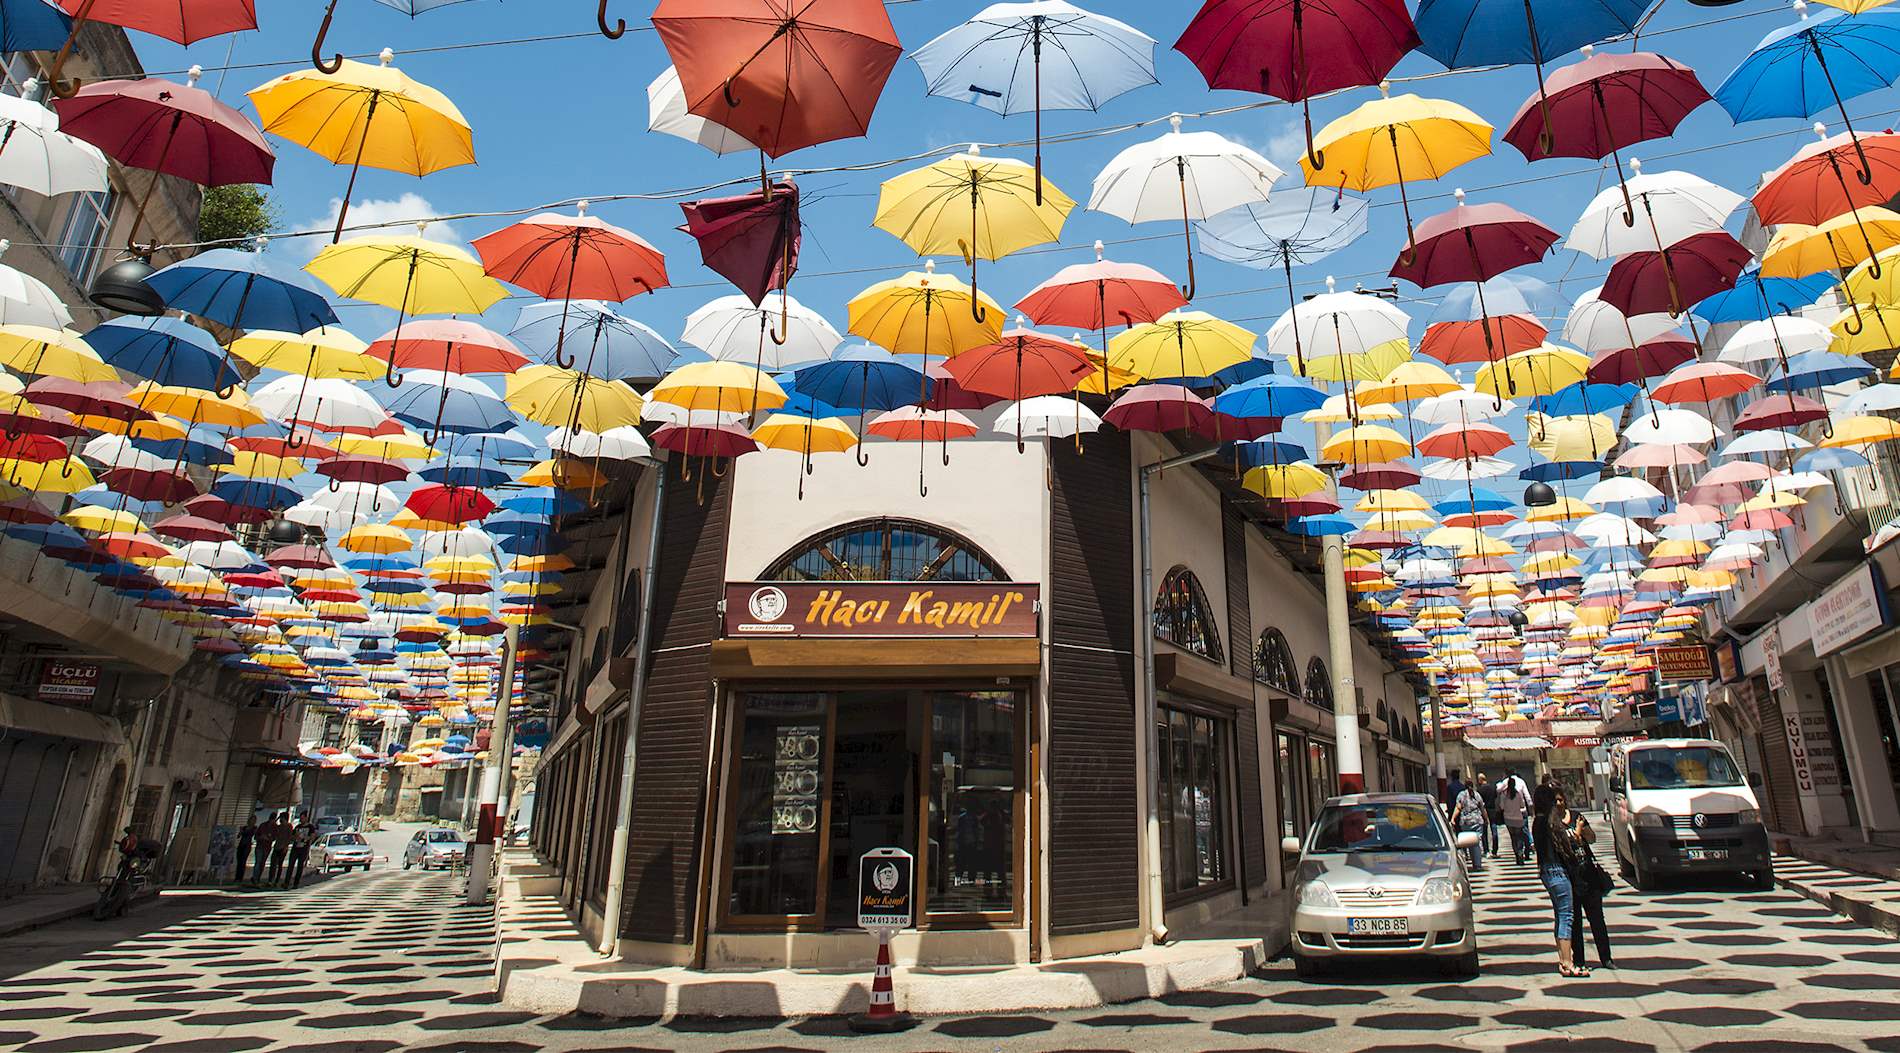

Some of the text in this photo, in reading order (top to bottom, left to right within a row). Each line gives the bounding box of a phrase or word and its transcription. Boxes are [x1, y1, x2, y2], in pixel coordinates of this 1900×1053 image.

[806, 590, 1014, 628] Hacı Kamil
[50, 664, 97, 678] ÜÇLÜ
[1574, 737, 1600, 745] KISMET
[1786, 717, 1812, 791] KUYUMCU
[861, 916, 908, 924] 0324 613 35 00
[1354, 919, 1406, 930] 33 NCB 85
